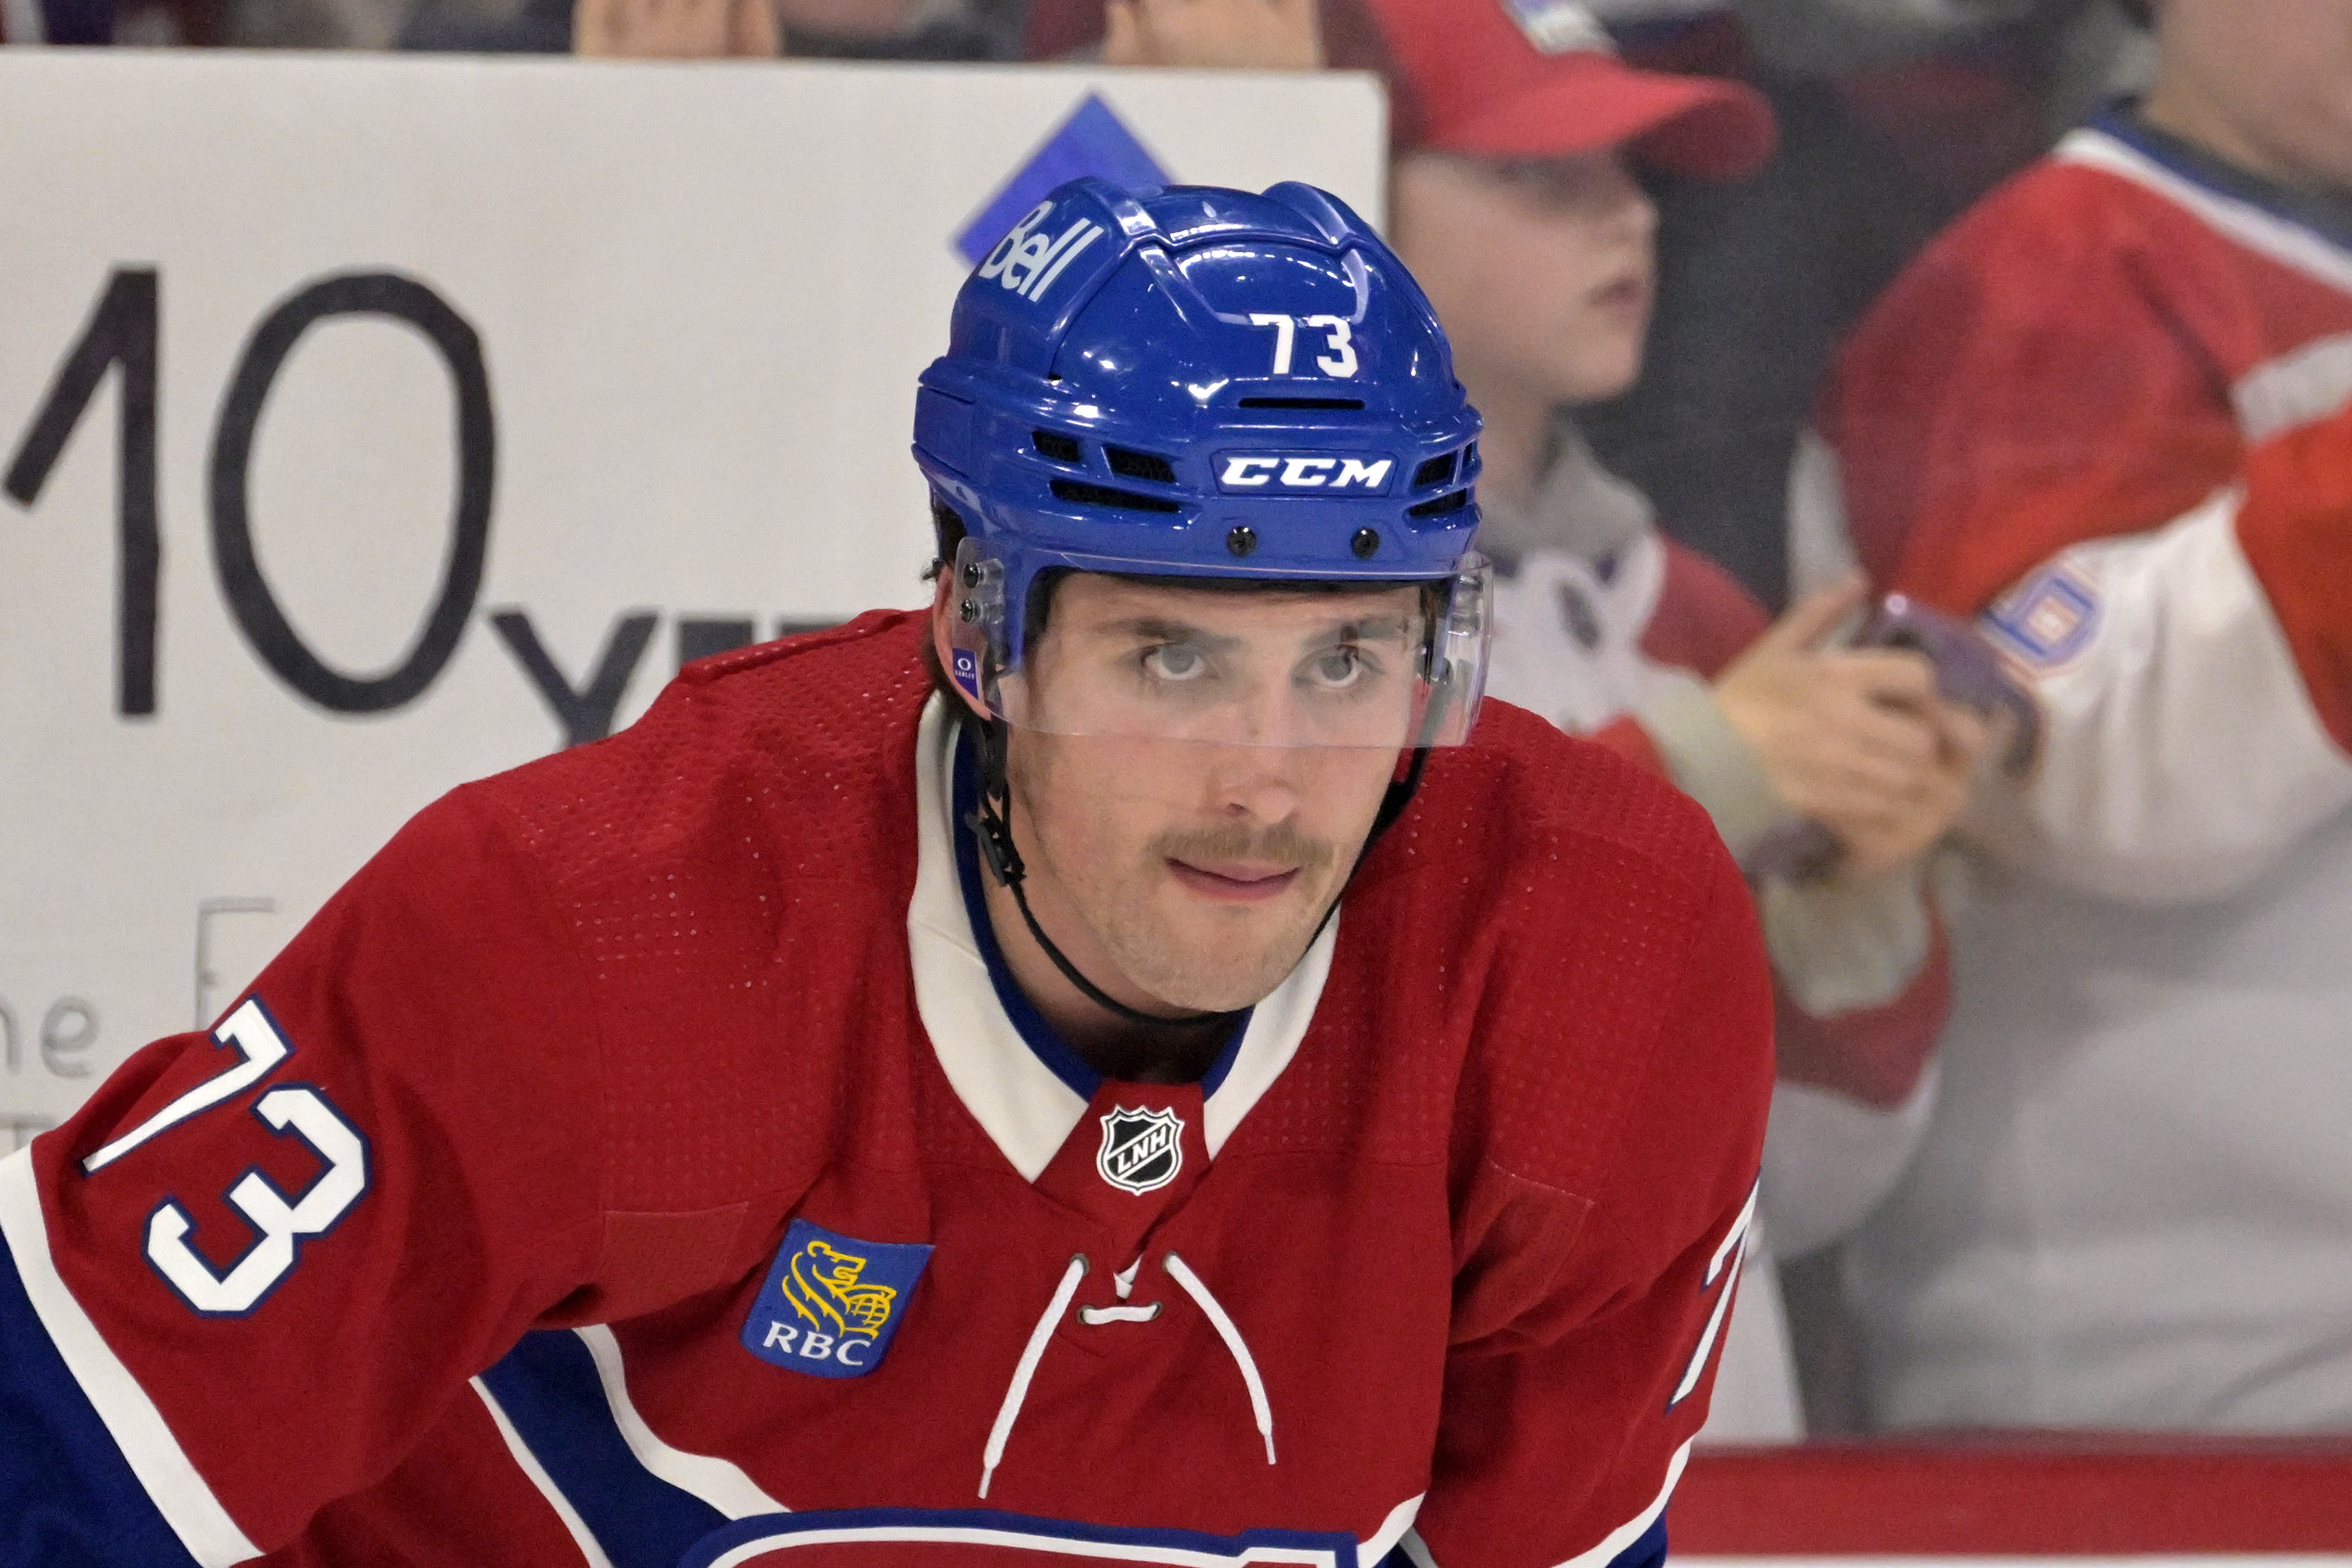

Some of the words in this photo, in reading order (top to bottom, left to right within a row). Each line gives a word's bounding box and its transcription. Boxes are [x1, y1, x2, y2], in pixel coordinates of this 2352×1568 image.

[979, 200, 1104, 302] Bell
[1249, 313, 1358, 378] 73
[4, 267, 493, 718] 10
[1221, 457, 1392, 488] CCM
[77, 993, 373, 1319] 73
[1117, 1125, 1167, 1175] LNH
[763, 1320, 871, 1366] RBC
